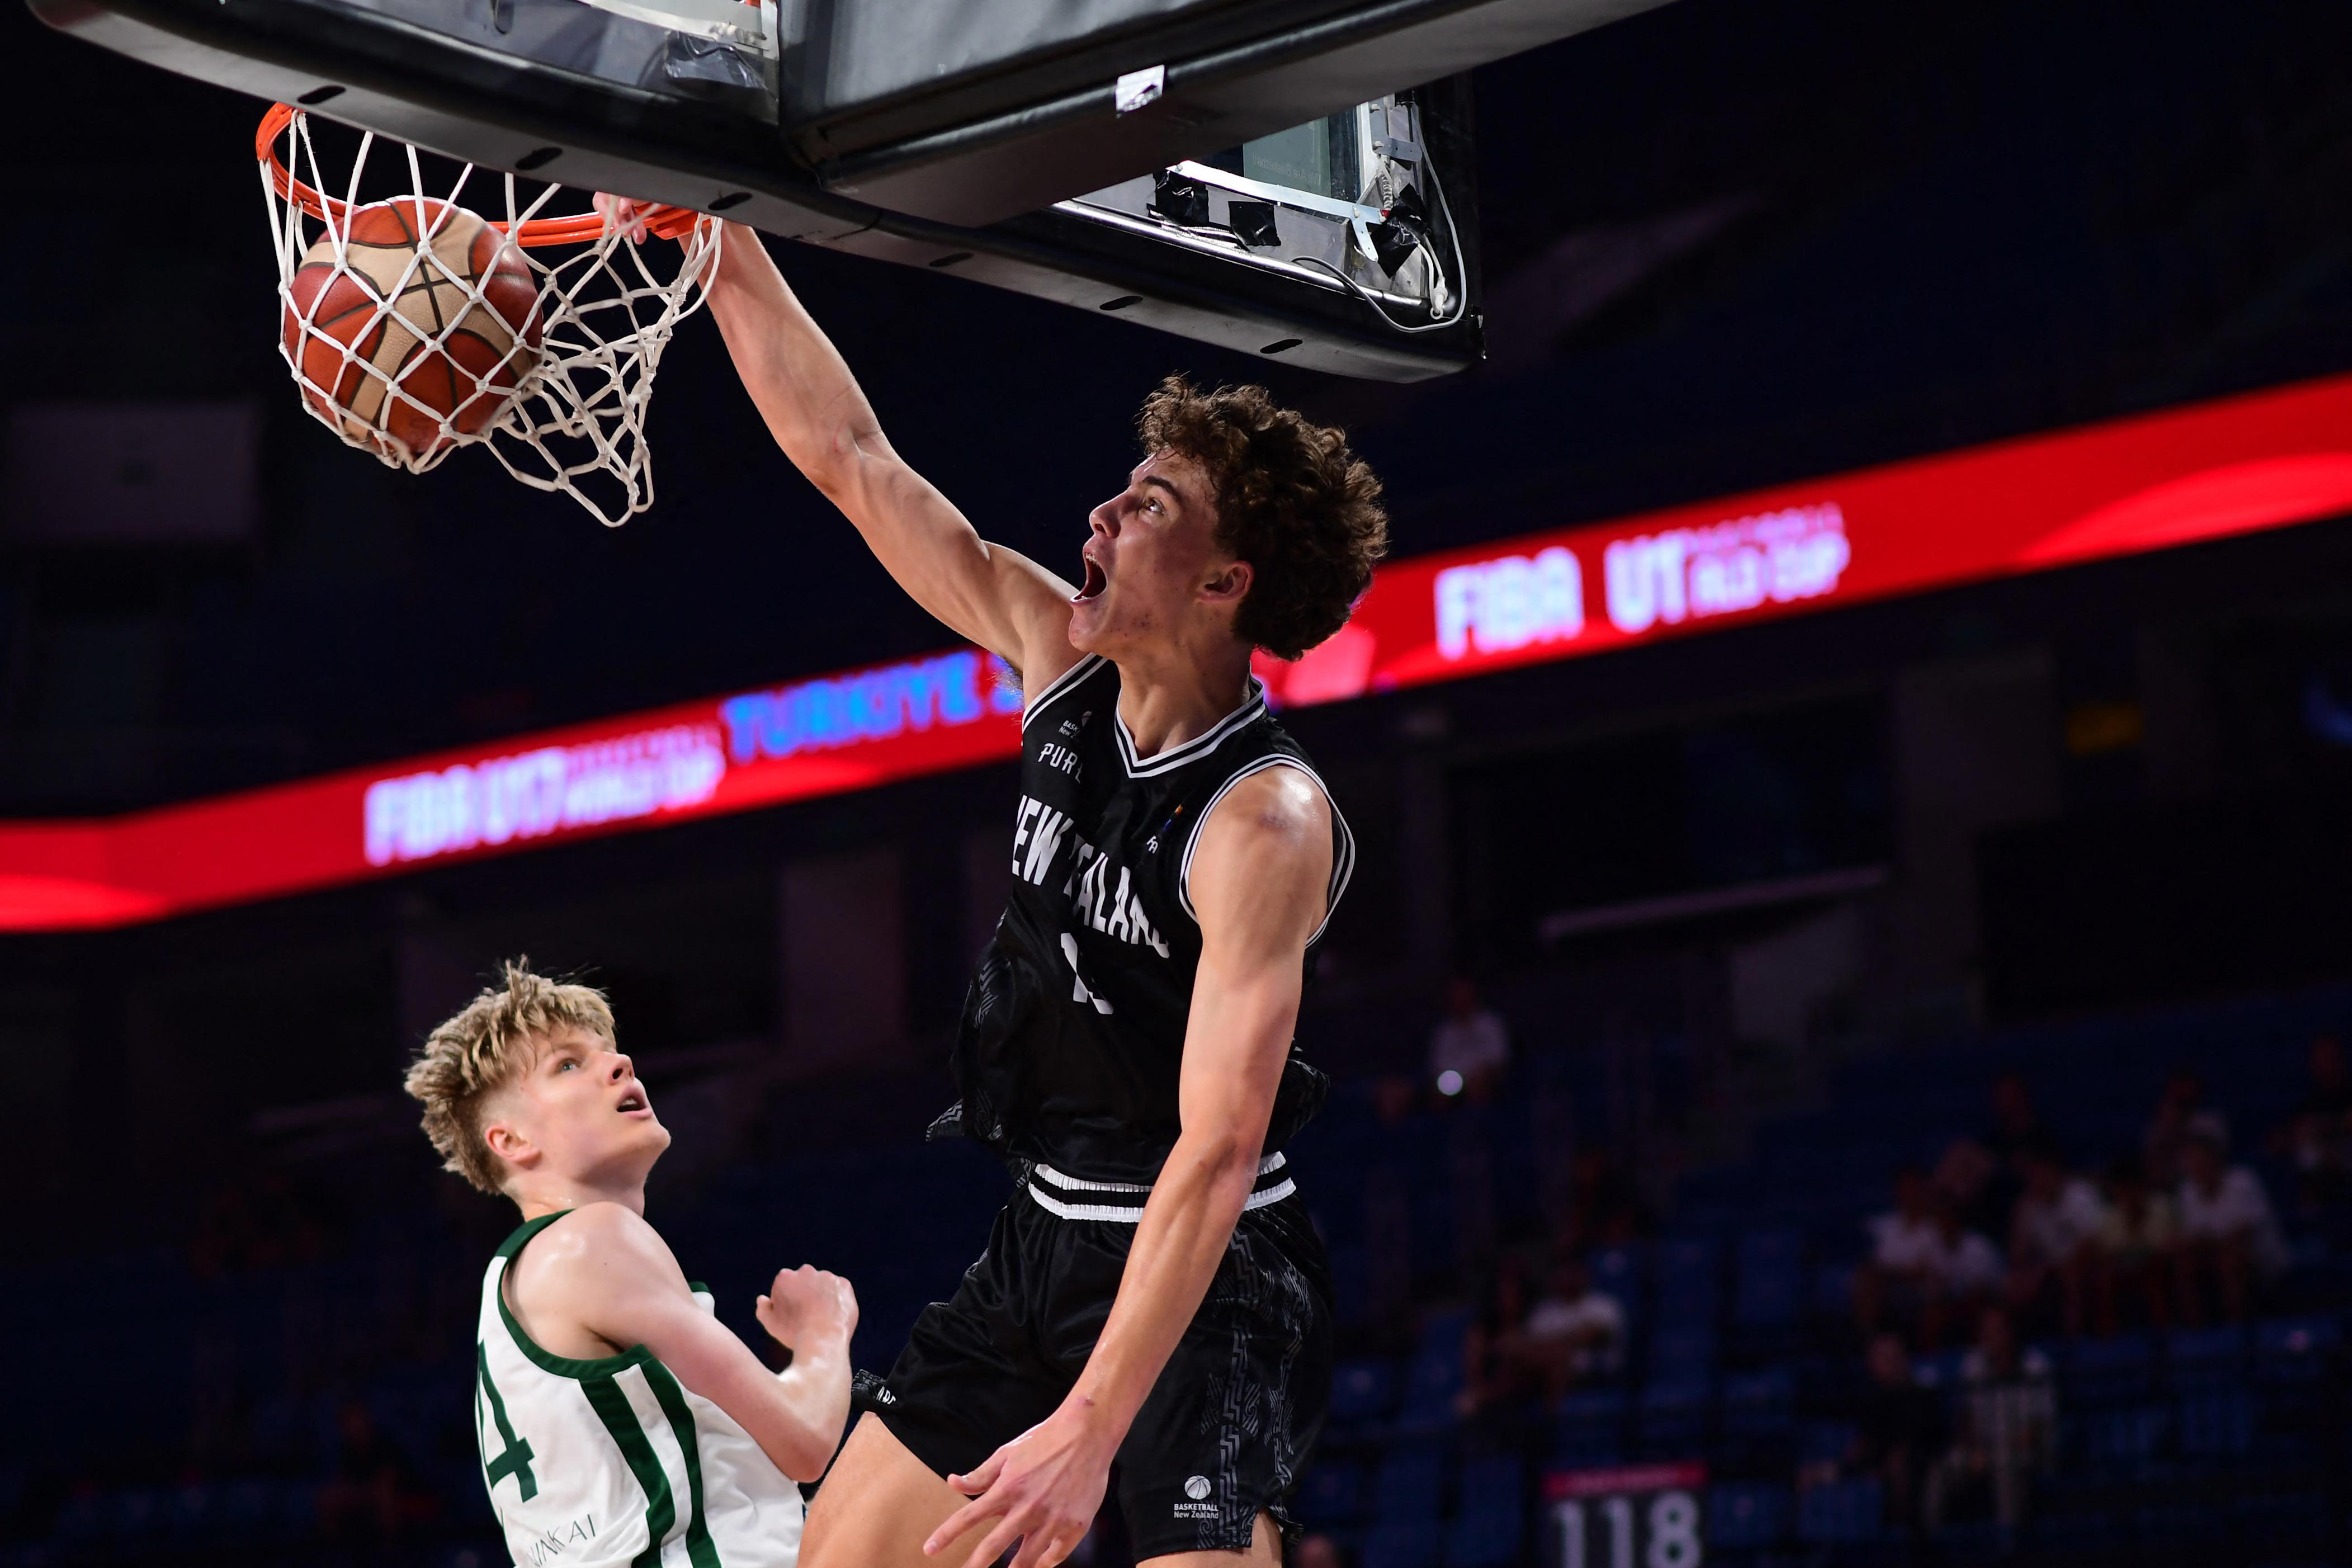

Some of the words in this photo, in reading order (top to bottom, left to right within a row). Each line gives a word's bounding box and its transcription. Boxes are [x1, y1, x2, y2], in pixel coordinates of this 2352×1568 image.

[1174, 1503, 1219, 1512] BASKETBALL
[1191, 1510, 1219, 1519] Zealand
[1550, 1489, 1701, 1568] 118
